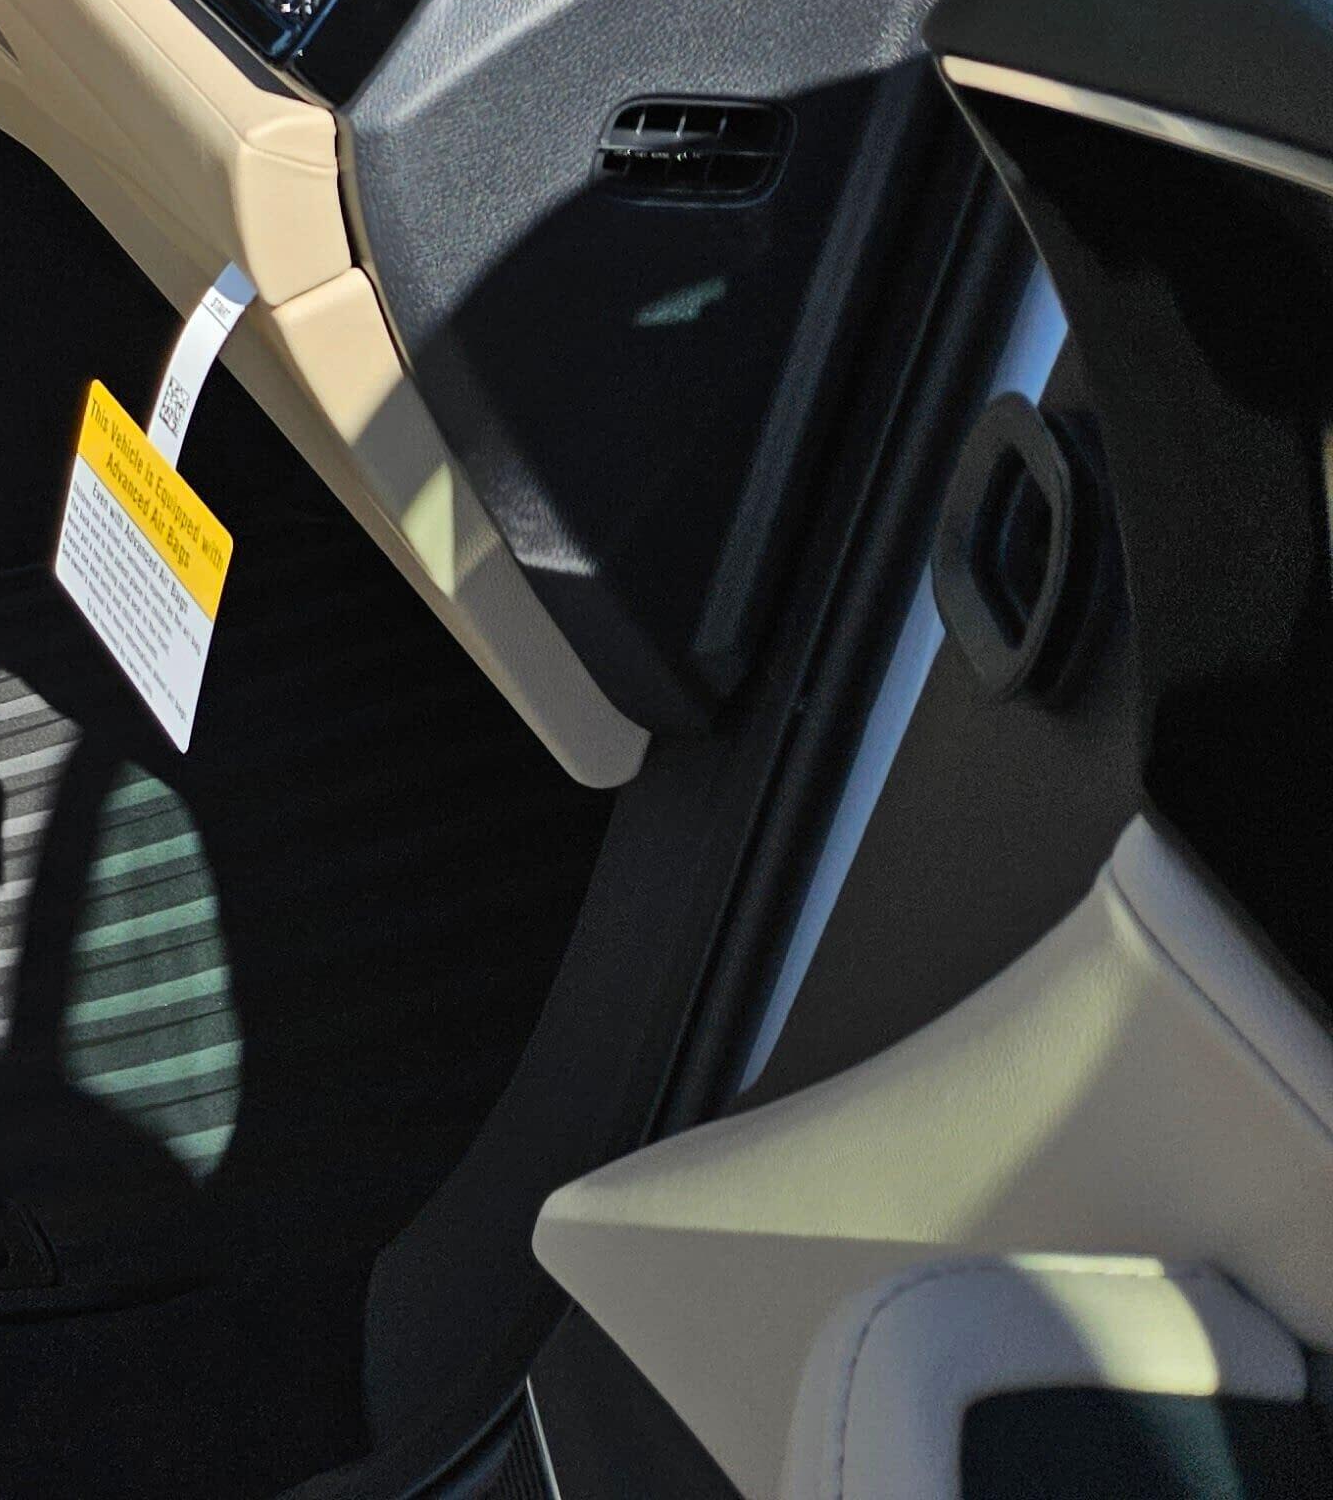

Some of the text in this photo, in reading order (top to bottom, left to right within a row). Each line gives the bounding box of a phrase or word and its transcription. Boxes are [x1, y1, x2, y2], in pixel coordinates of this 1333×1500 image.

[89, 396, 225, 574] This Vehicle is Equipped with
[91, 480, 189, 618] Even with Advanced Air Bags
[105, 449, 192, 573] Advanced Air Bags
